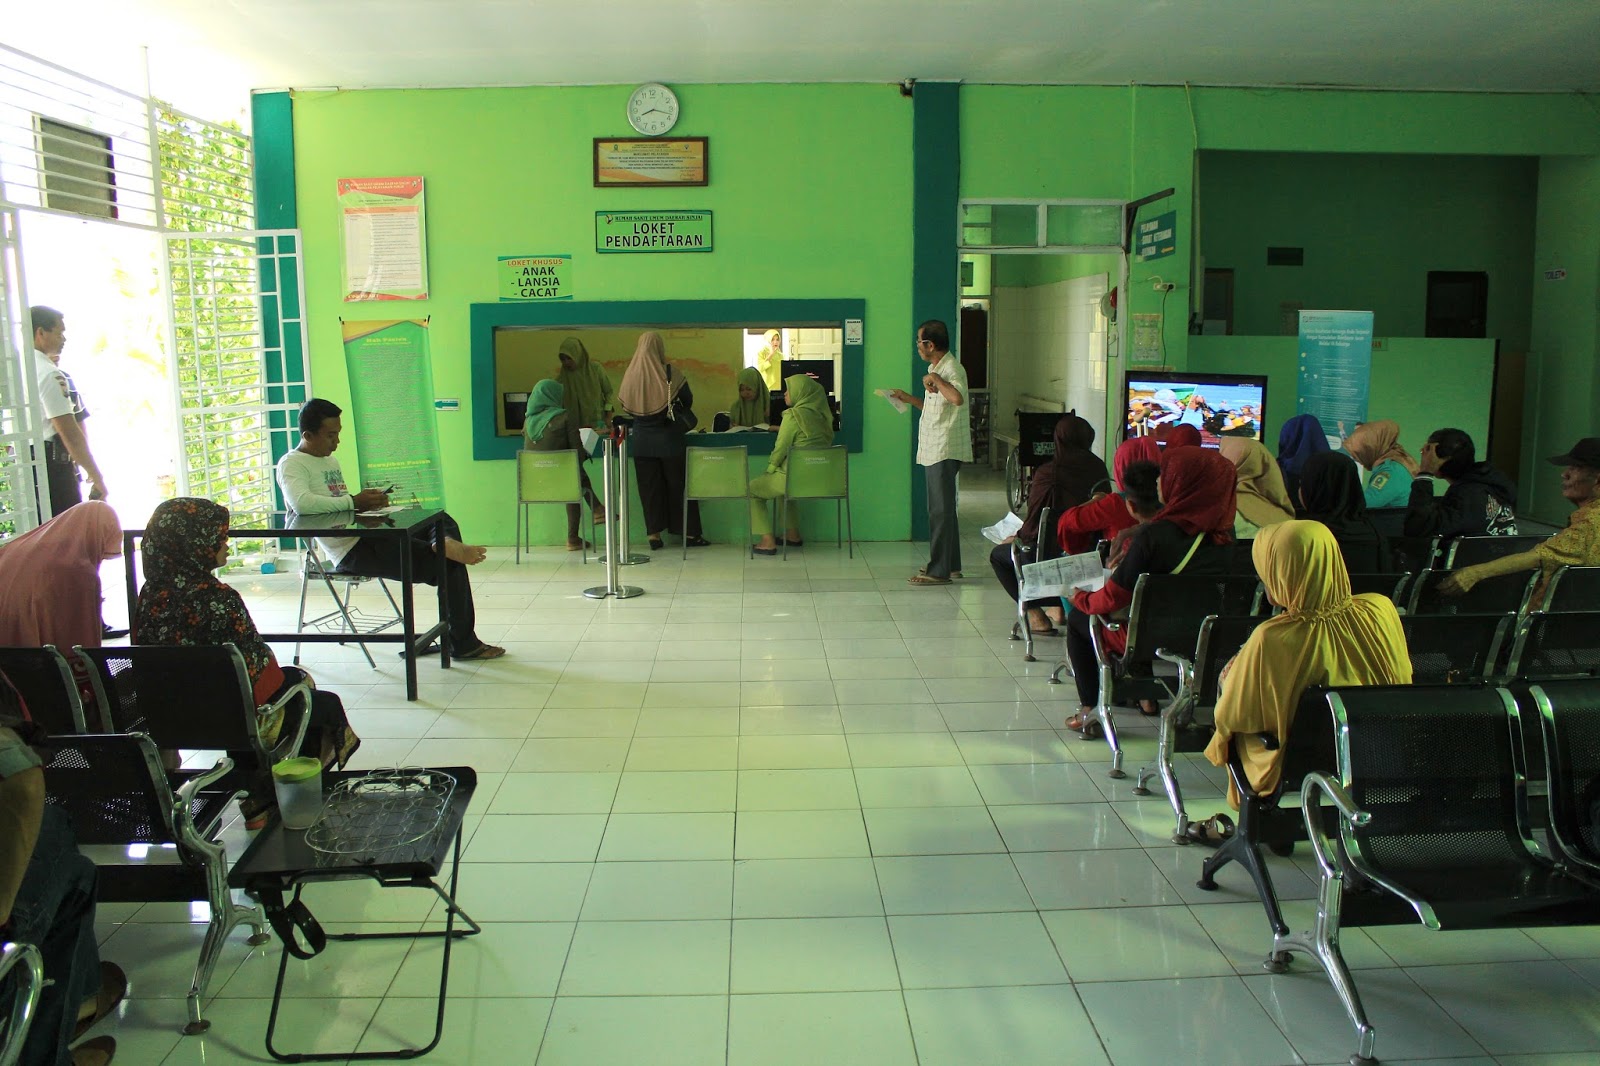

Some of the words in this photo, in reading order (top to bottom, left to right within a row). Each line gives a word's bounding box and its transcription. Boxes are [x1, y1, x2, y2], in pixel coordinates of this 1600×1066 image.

[634, 223, 675, 234] LOKET
[606, 235, 702, 247] PENDAFTARAN
[523, 267, 555, 276] ANAK
[518, 277, 560, 286] LANSIA
[521, 288, 558, 297] CACAT
